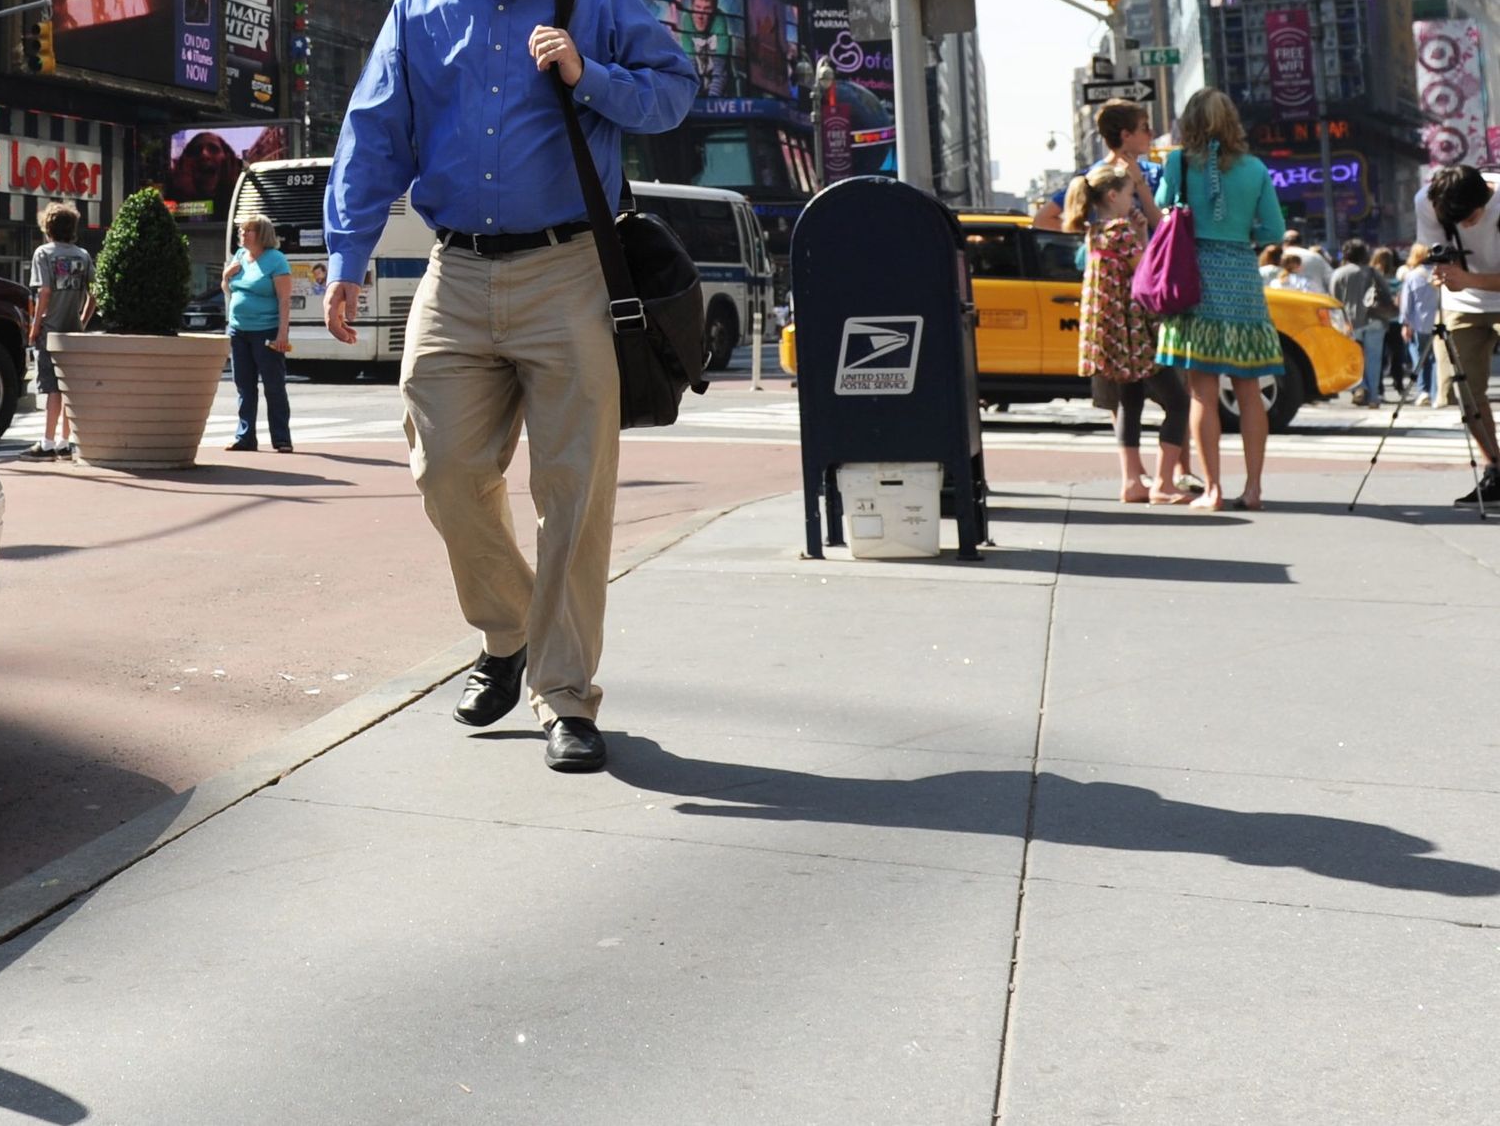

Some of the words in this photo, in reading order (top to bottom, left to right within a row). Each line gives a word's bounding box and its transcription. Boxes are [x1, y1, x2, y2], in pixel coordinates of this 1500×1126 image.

[184, 33, 194, 48] ON
[195, 34, 211, 51] DVD
[1274, 47, 1305, 60] FREE
[186, 63, 209, 83] NOW
[706, 100, 737, 114] LIVE
[741, 99, 753, 113] IT
[10, 140, 102, 196] Locker
[287, 173, 315, 186] 8932
[841, 373, 874, 381] UNITED
[876, 373, 905, 381] STATES
[839, 381, 873, 390] POSTAL
[874, 380, 908, 390] SERVICE
